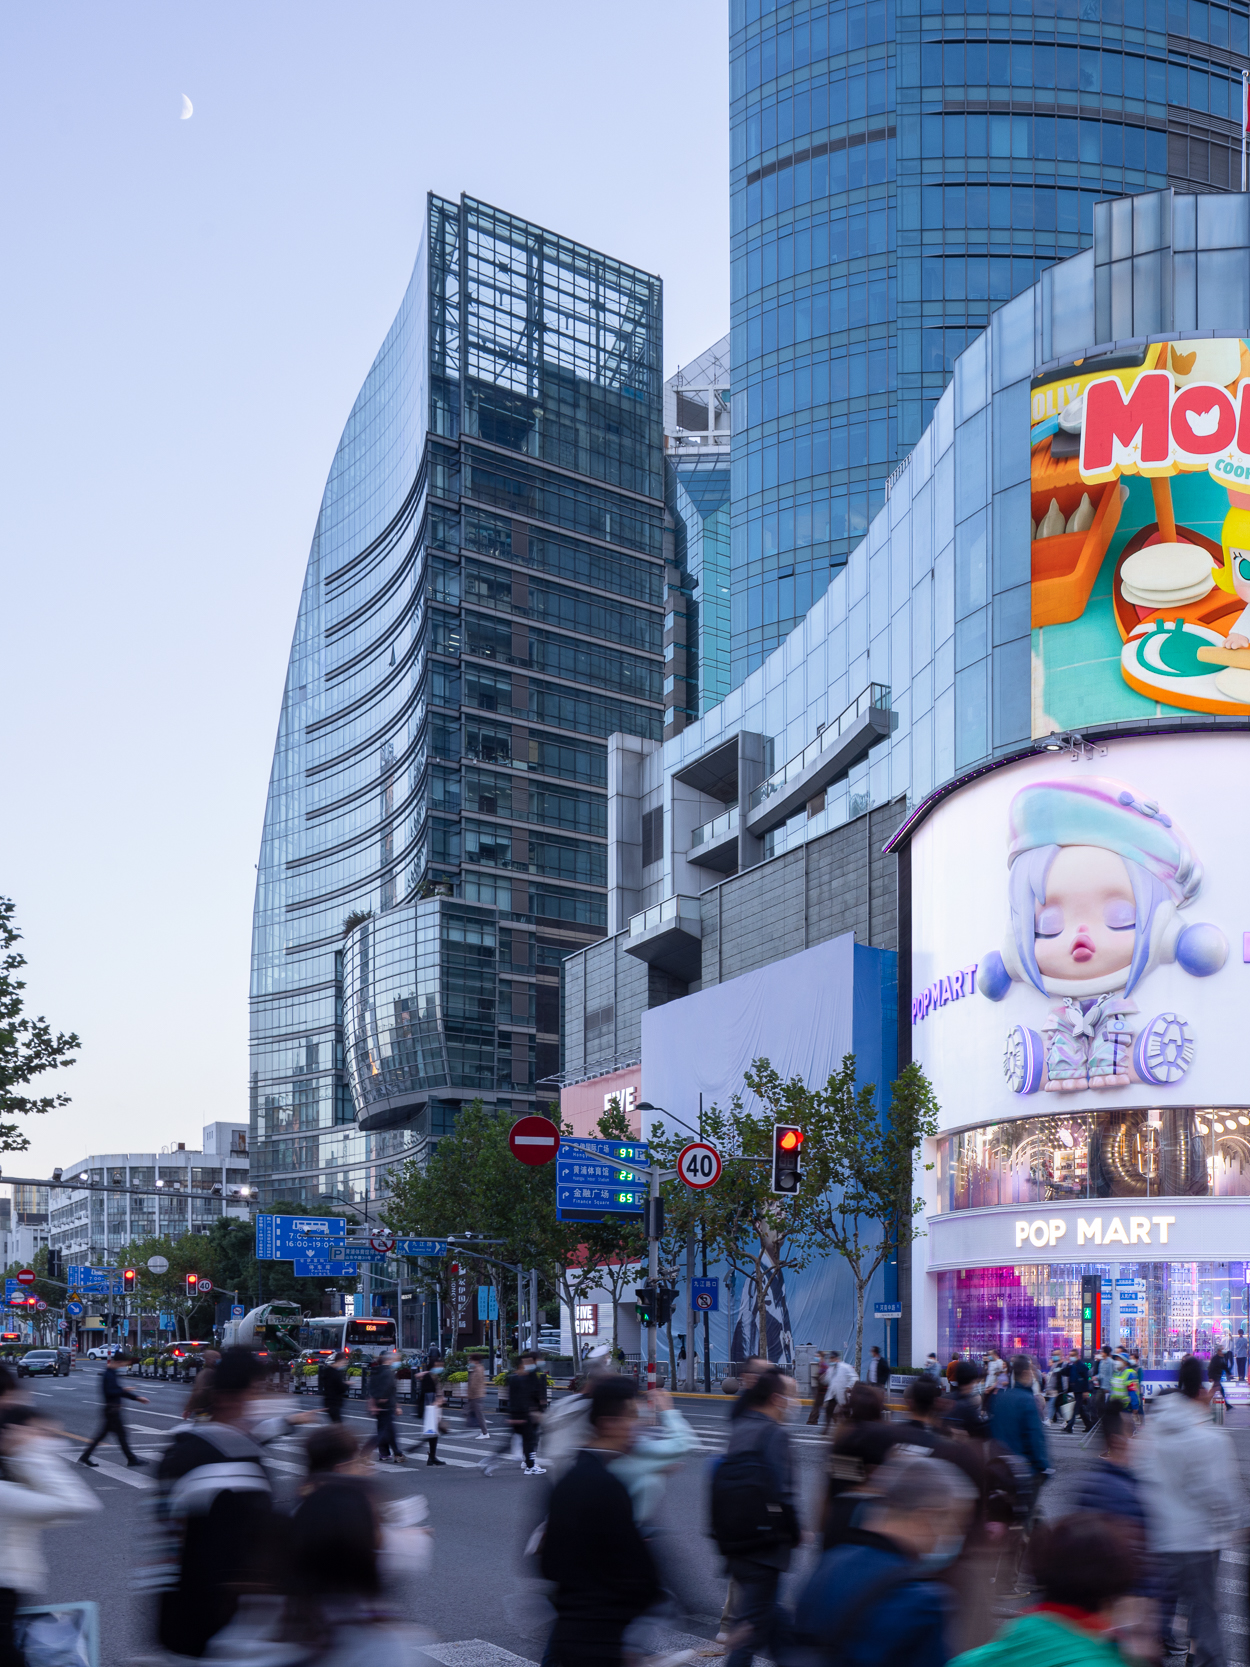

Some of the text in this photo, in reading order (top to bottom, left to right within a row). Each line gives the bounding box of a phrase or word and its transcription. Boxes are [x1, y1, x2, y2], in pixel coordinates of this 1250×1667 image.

[619, 1148, 634, 1158] 97
[572, 1165, 610, 1176] 黄浦体育馆
[686, 1154, 713, 1178] 40
[572, 1188, 610, 1199] 金融广场
[619, 1193, 633, 1203] 65
[1015, 1215, 1176, 1248] POP MART
[199, 1282, 210, 1290] 40
[693, 1280, 717, 1288] 九江路口
[576, 1305, 592, 1319] FIVE
[575, 1319, 594, 1334] GUYS
